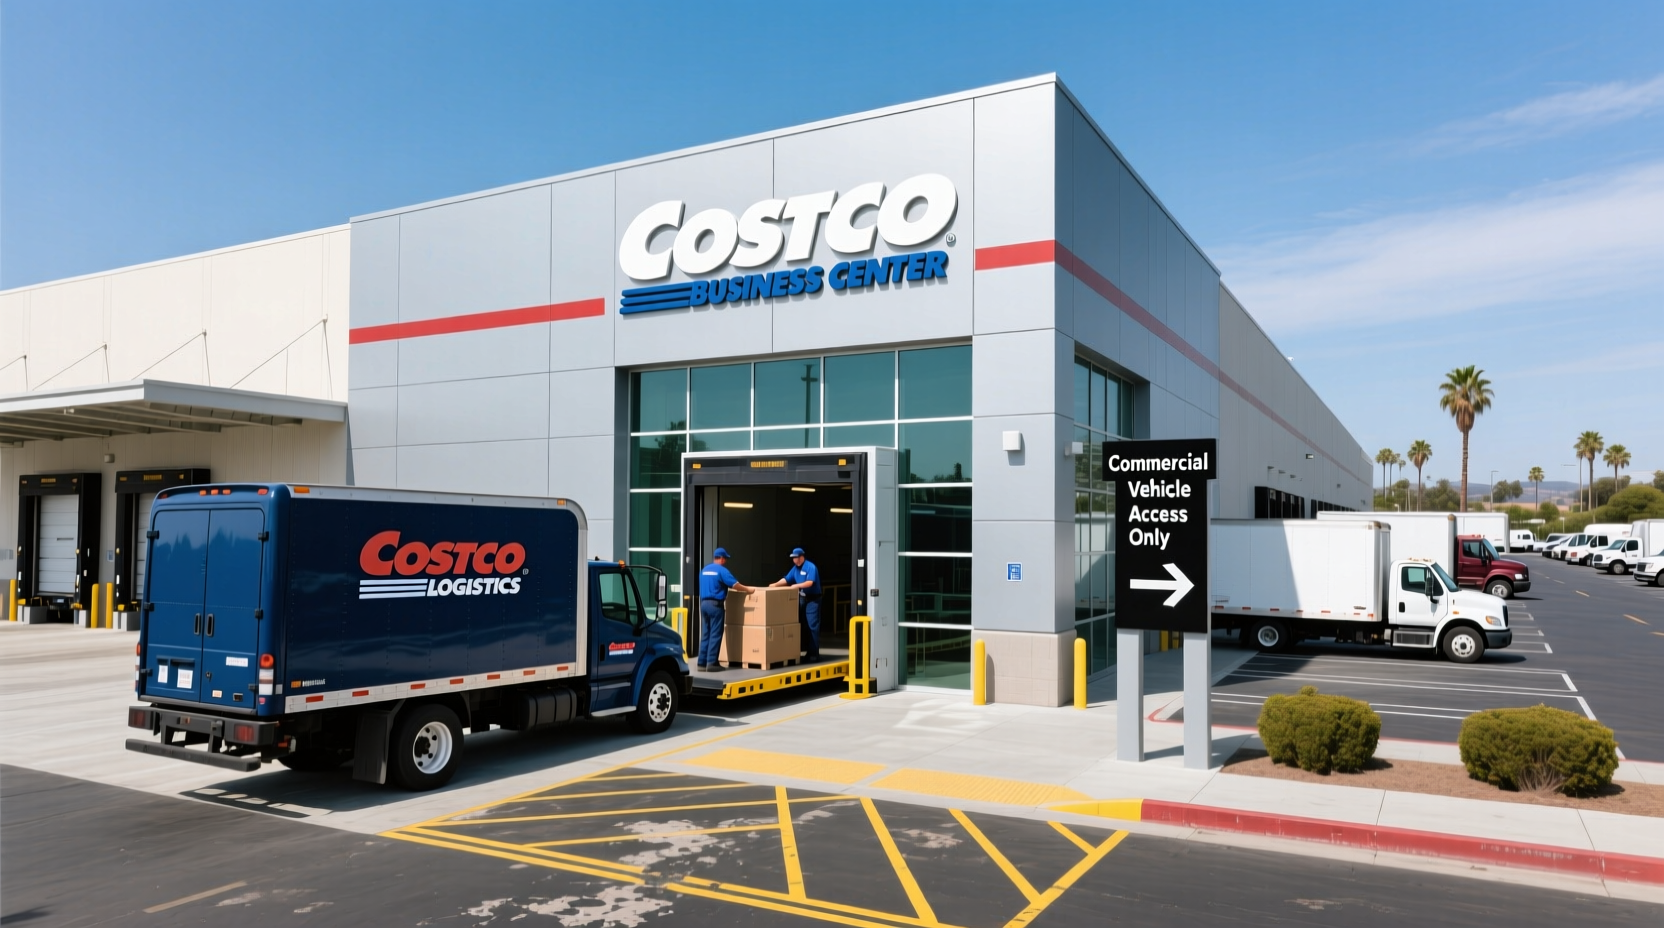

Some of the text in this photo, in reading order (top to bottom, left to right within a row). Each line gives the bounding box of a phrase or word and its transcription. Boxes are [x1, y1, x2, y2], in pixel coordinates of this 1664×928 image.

[619, 173, 958, 280] COSTCO
[690, 250, 949, 307] BUSINESS CENTER
[1108, 452, 1208, 472] Commercial
[1127, 478, 1191, 498] Vehicle
[1128, 505, 1188, 523] Access
[1129, 527, 1170, 550] Only
[359, 530, 526, 576] COSTCO
[426, 577, 522, 597] LOGISTICS
